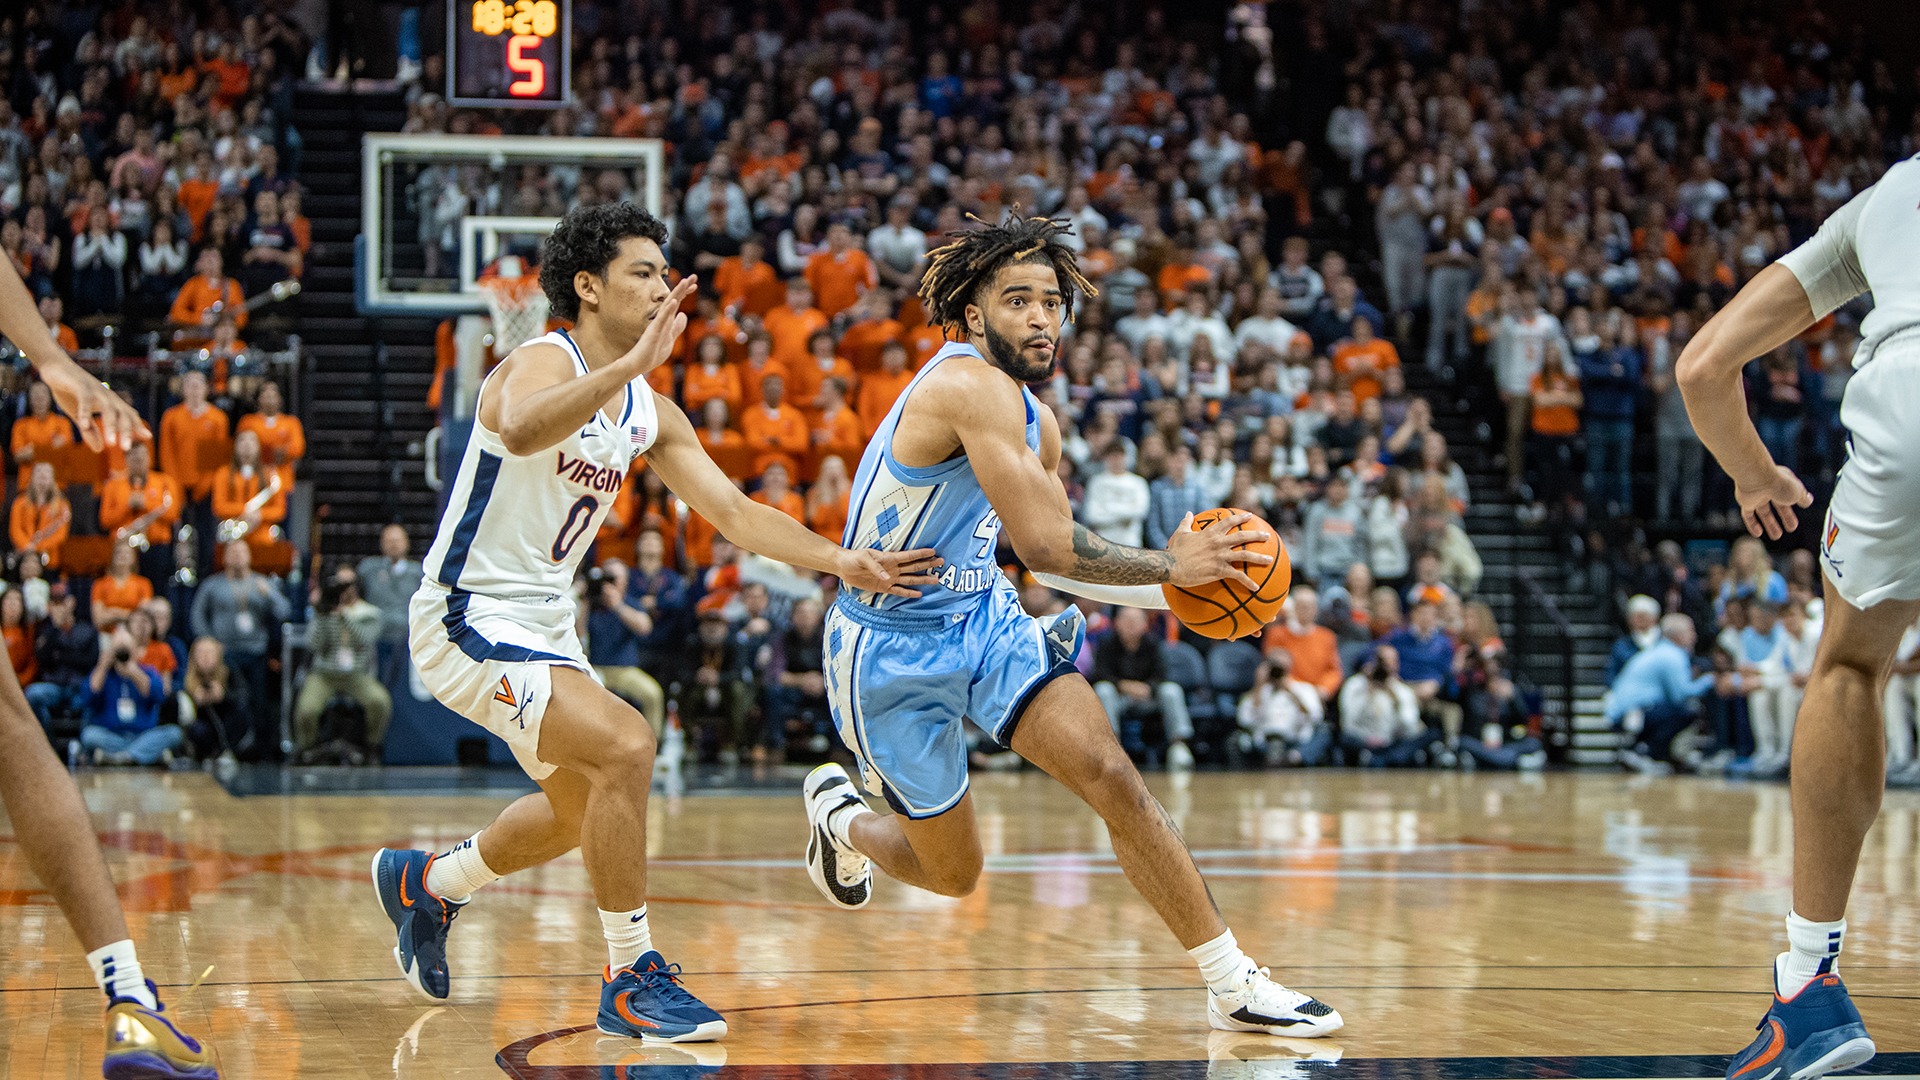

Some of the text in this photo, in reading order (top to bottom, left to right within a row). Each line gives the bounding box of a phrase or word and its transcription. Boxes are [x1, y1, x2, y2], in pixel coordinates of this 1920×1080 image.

[506, 34, 545, 97] 5
[556, 450, 622, 493] VIRGIN
[552, 494, 598, 562] 0
[972, 507, 1000, 559] 4
